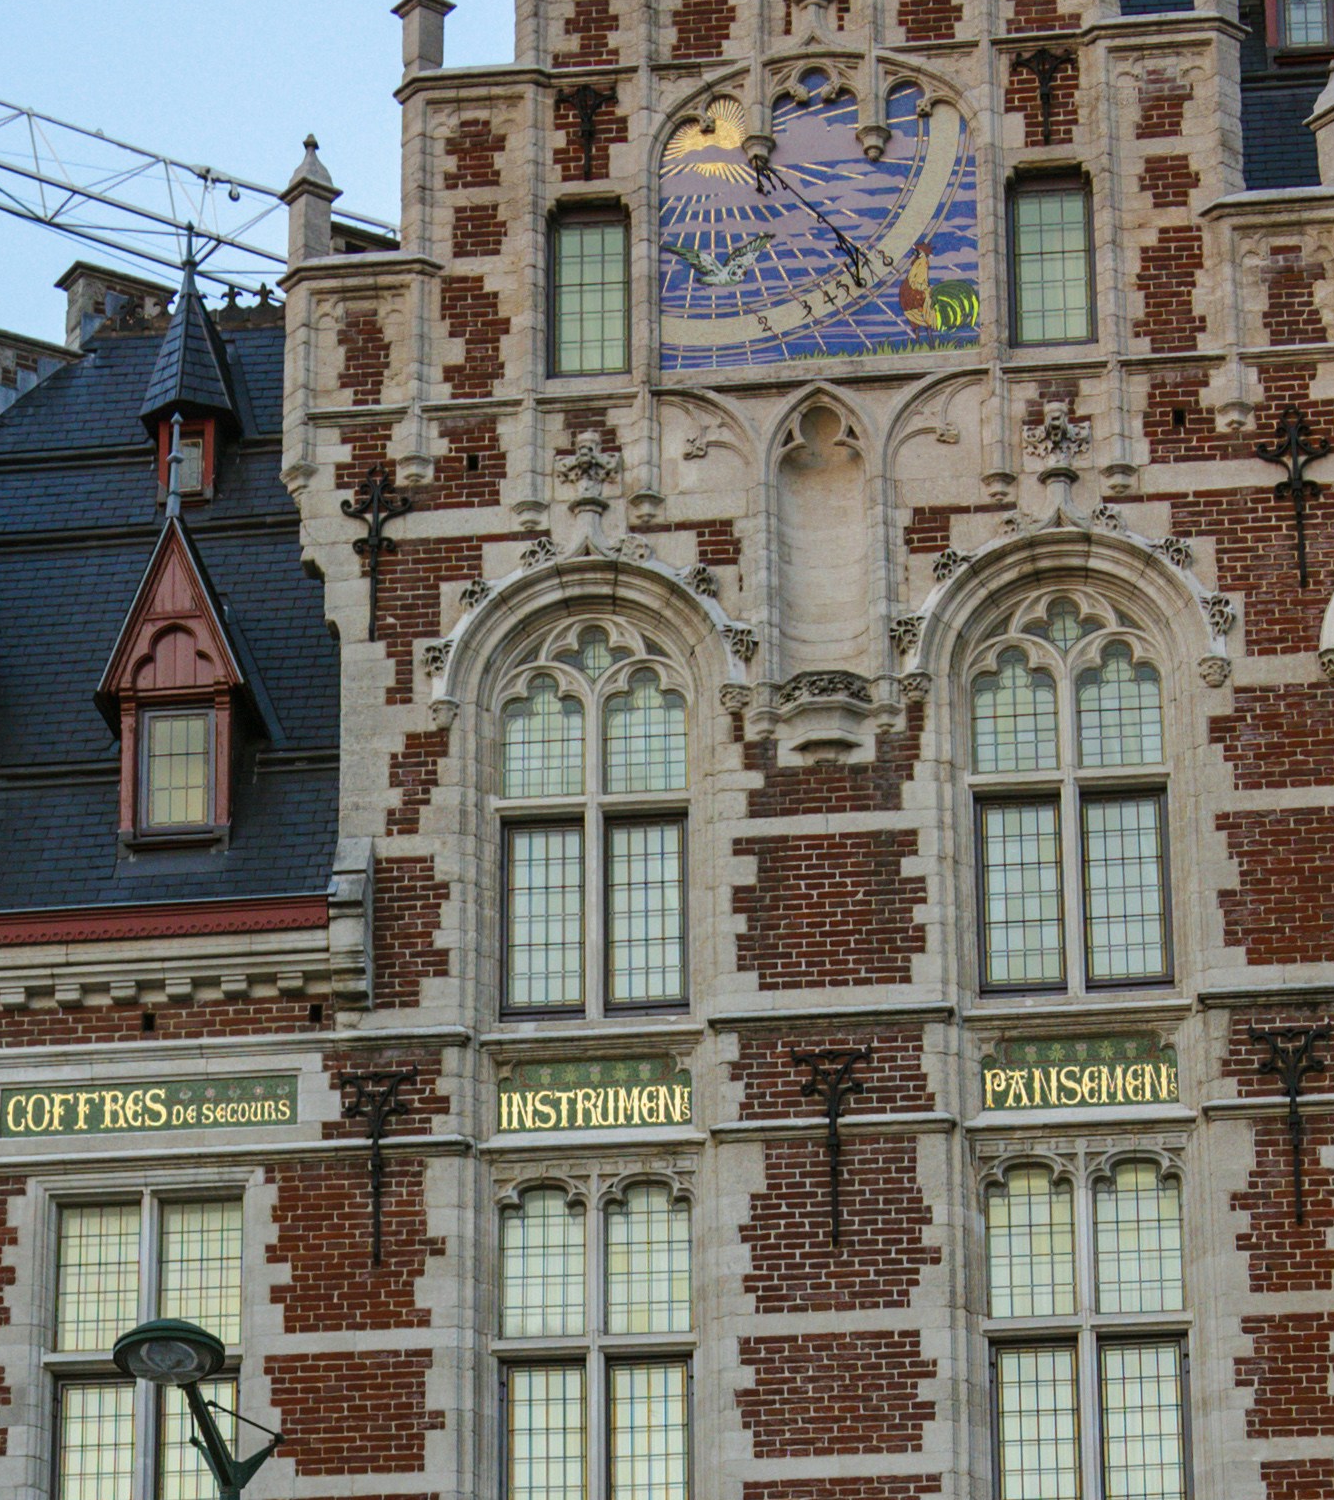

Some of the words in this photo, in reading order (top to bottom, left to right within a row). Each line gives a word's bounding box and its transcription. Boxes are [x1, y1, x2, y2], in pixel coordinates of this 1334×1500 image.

[6, 1087, 168, 1132] COFFRES
[171, 1104, 198, 1126] DE
[201, 1099, 291, 1125] SECOURS
